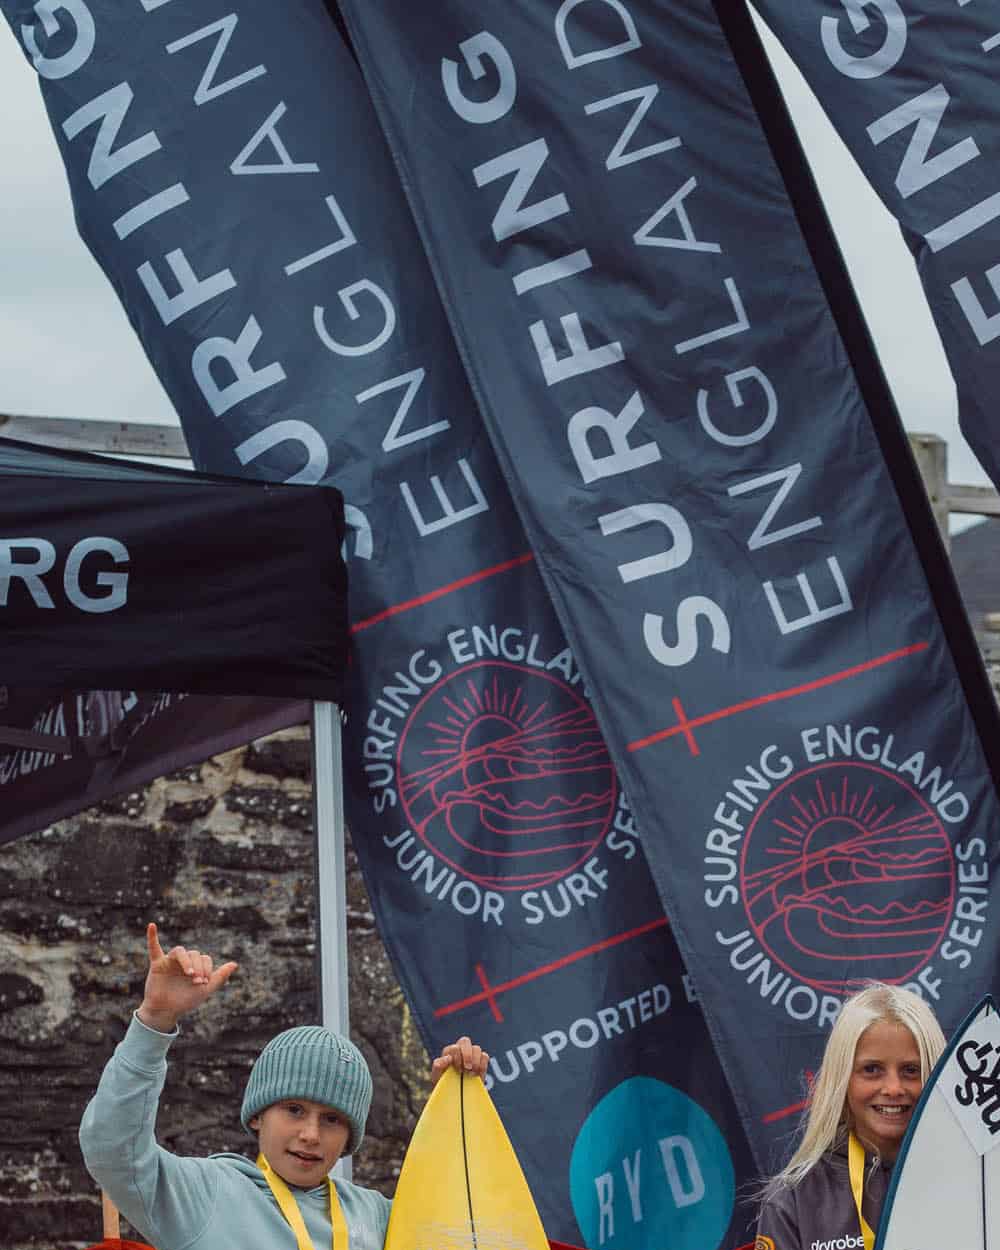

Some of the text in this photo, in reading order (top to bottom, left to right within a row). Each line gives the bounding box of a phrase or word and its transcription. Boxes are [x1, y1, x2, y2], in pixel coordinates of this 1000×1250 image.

[142, 0, 489, 537] ENGLAN
[441, 30, 731, 667] SURFING
[554, 0, 854, 635] ENGLAND
[363, 650, 443, 814] SURFING
[383, 829, 505, 926] JUNIOR
[521, 856, 609, 925] SURF
[704, 724, 970, 908] SURFING ENGLAND
[715, 929, 847, 1028] JUNIOR
[940, 837, 990, 969] SERIES
[594, 1133, 706, 1246] RYD
